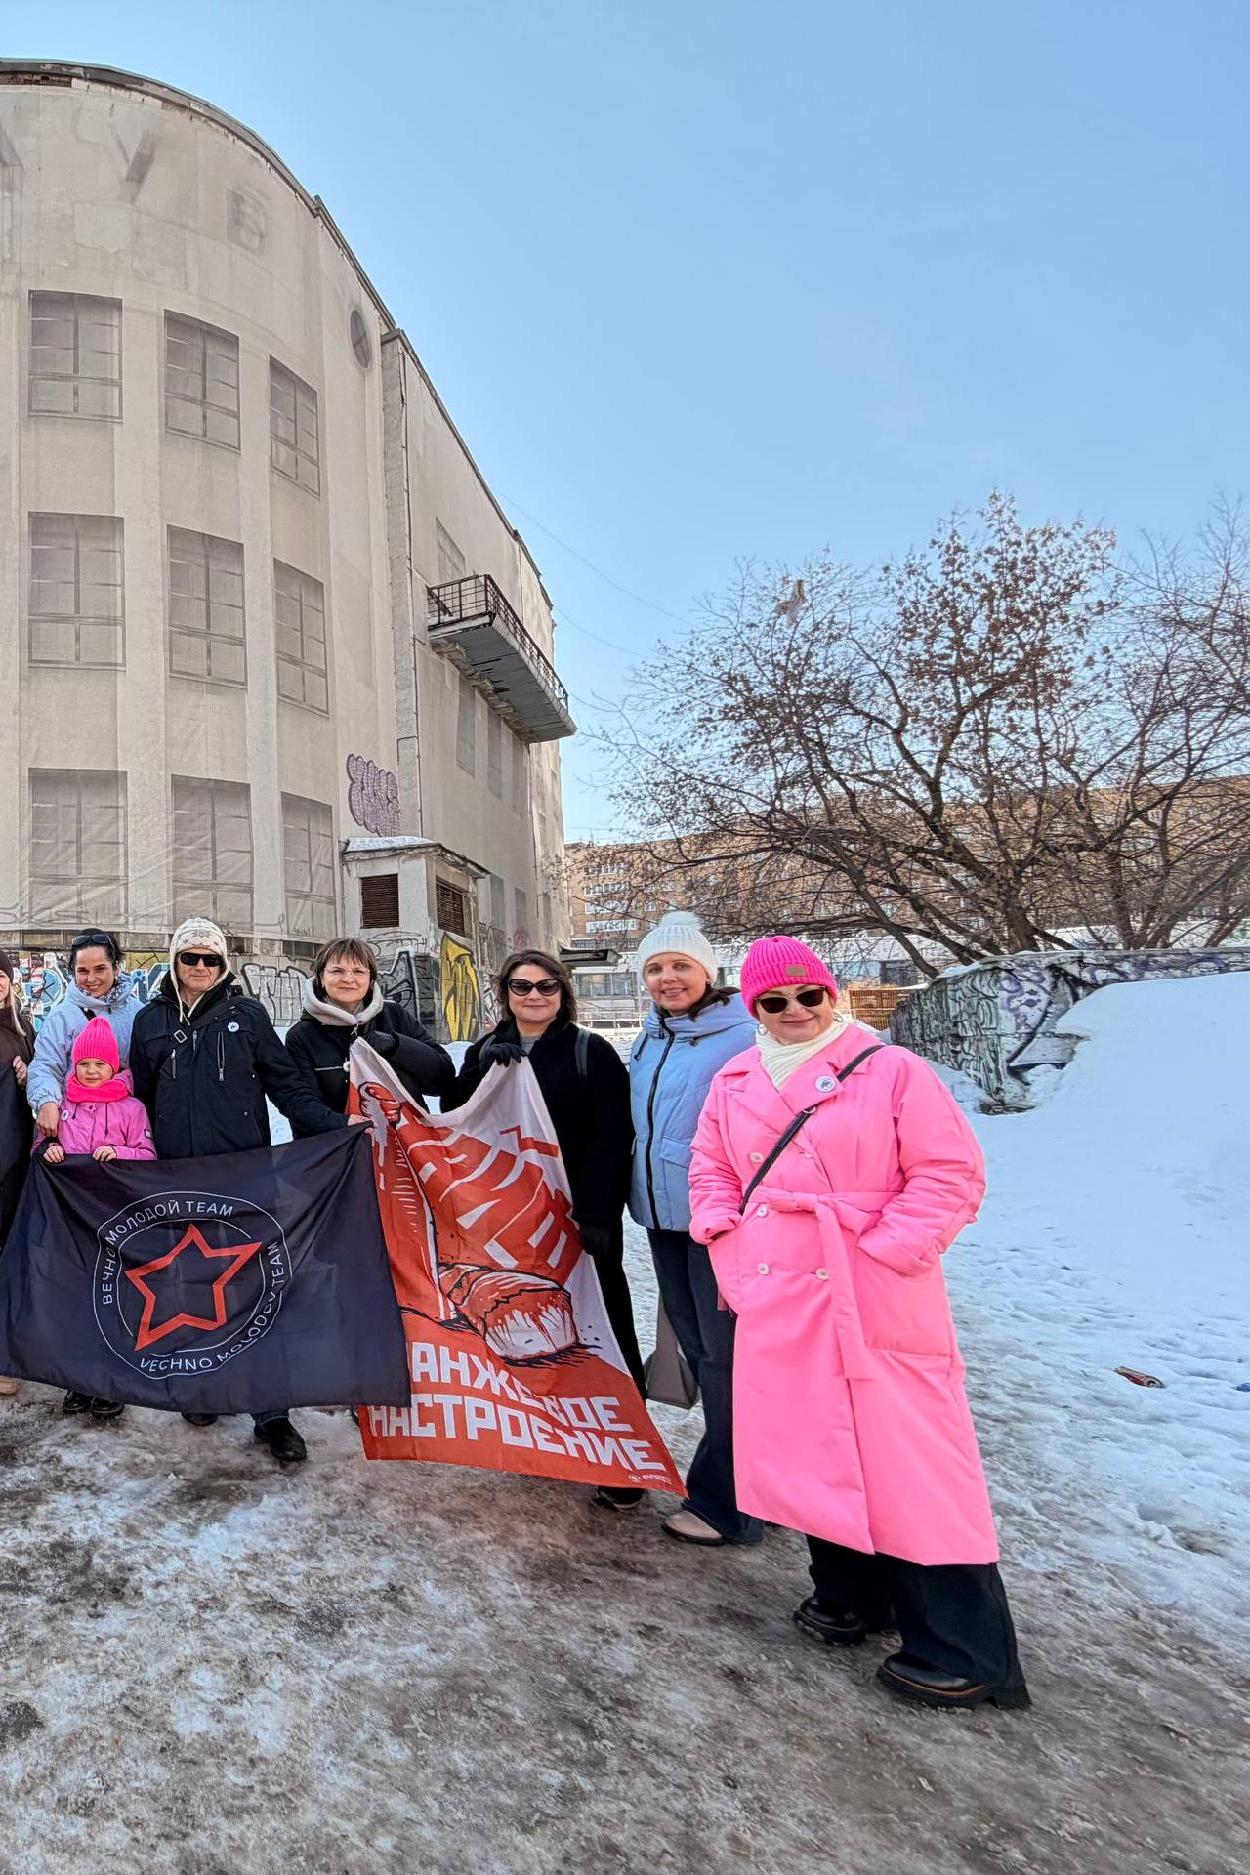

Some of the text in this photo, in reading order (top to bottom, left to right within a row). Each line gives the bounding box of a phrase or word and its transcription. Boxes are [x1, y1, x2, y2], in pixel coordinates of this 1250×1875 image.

[102, 1199, 234, 1305] ВЕЧНО МОЛОДОЙ TEAM
[140, 1356, 214, 1372] VECHNO
[268, 1242, 286, 1288] TEAM
[368, 1394, 665, 1473] НАСТРОЕНИЕ
